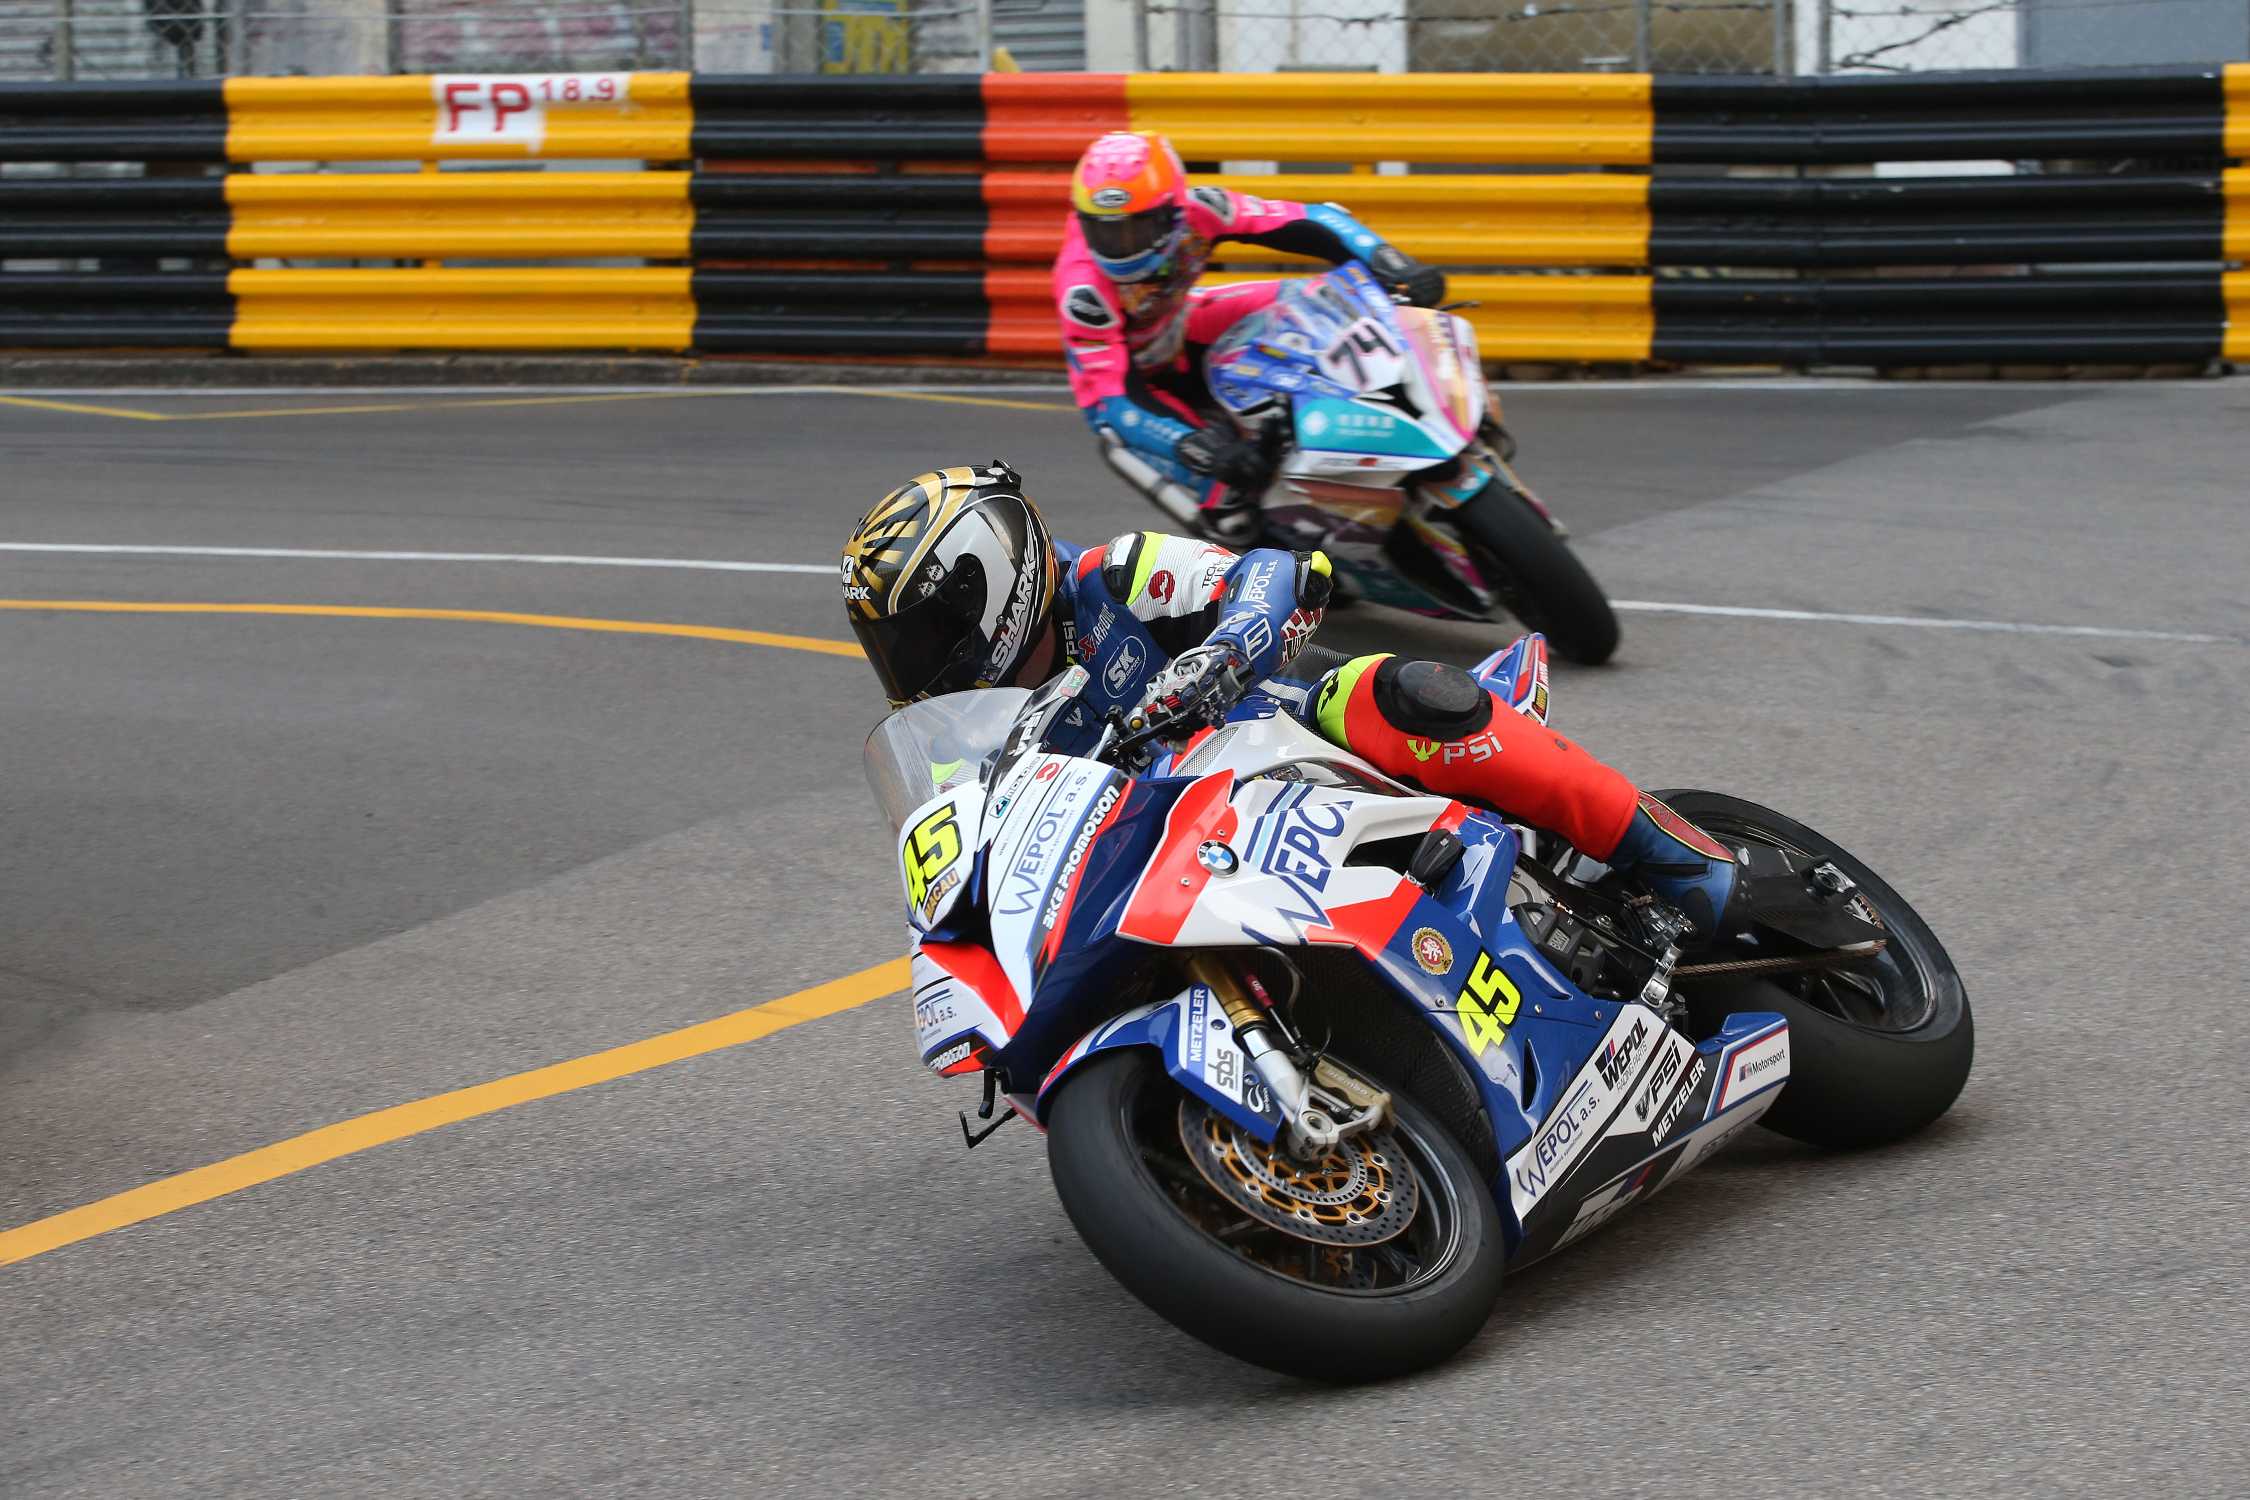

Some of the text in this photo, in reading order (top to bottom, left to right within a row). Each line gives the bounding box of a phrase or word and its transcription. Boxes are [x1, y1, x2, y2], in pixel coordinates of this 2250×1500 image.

[444, 83, 533, 132] FP
[537, 77, 616, 102] 18.9
[1328, 324, 1399, 385] 74
[842, 586, 872, 600] ARK
[991, 547, 1037, 669] SHARK
[1250, 573, 1273, 615] WEPOL
[1107, 644, 1139, 690] SK
[903, 800, 963, 915] 45
[1000, 806, 1068, 915] WEPOL
[1065, 771, 1093, 803] a.s.
[1190, 988, 1207, 1062] METZELER
[1455, 945, 1524, 1057] 45
[1208, 1048, 1234, 1090] sbs
[1602, 1017, 1649, 1091] WEPOL
[1752, 1049, 1785, 1075] Motorsport
[1652, 1057, 1706, 1148] METZELER
[1516, 1112, 1580, 1198] WEPOL
[1579, 1096, 1601, 1121] a.s.
